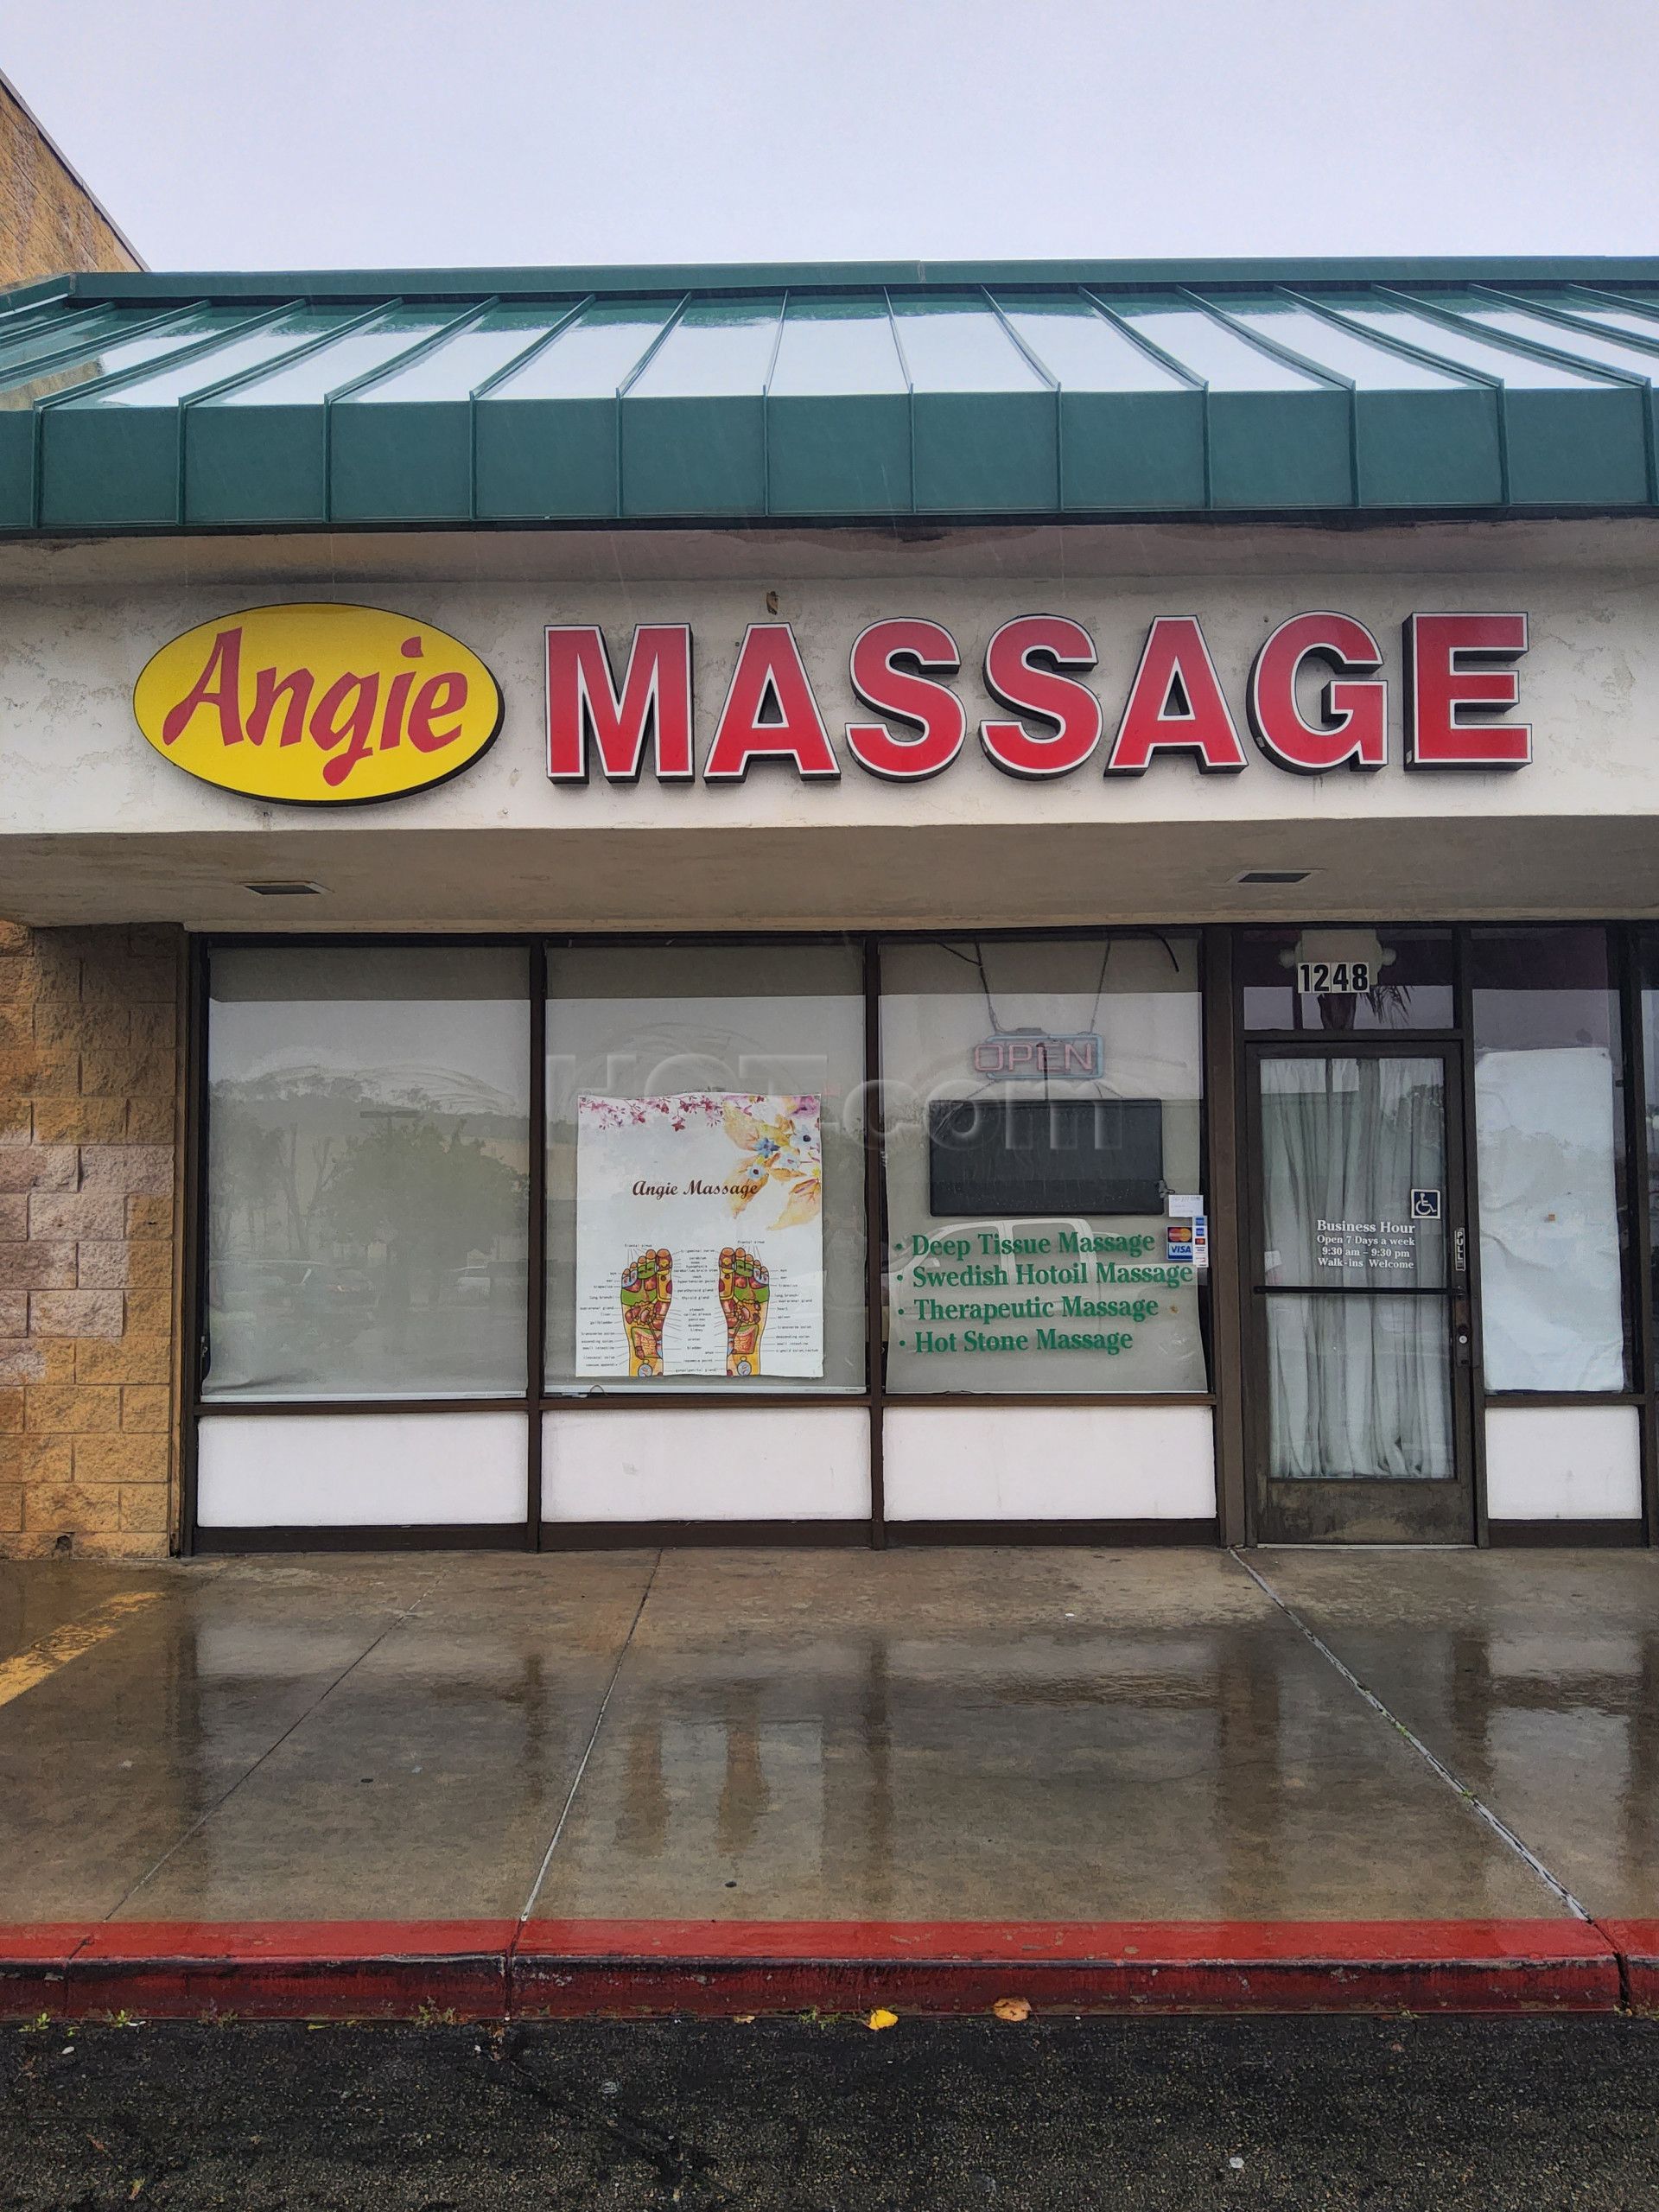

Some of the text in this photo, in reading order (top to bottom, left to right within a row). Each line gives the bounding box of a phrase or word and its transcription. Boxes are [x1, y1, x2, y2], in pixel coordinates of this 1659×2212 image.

[162, 610, 1533, 787] Angie MASSAGE
[1300, 963, 1368, 992] 1248
[975, 1043, 1094, 1071] OPEN
[632, 1179, 760, 1200] Angie Massage
[1317, 1219, 1415, 1233] Business Hour
[912, 1231, 1155, 1261] Deep Tissue Massage
[1172, 1245, 1192, 1254] VISA
[1317, 1235, 1343, 1245] Open
[1355, 1236, 1378, 1246] Days
[1322, 1247, 1343, 1255] 9:30
[1395, 1249, 1410, 1259] pm
[912, 1262, 1193, 1288] Swedish Hotoil Massage
[1318, 1258, 1414, 1268] Walk-ins Welcome
[914, 1296, 1159, 1324] Therapeutic Massage
[915, 1328, 1133, 1355] Hot Stone Massage
